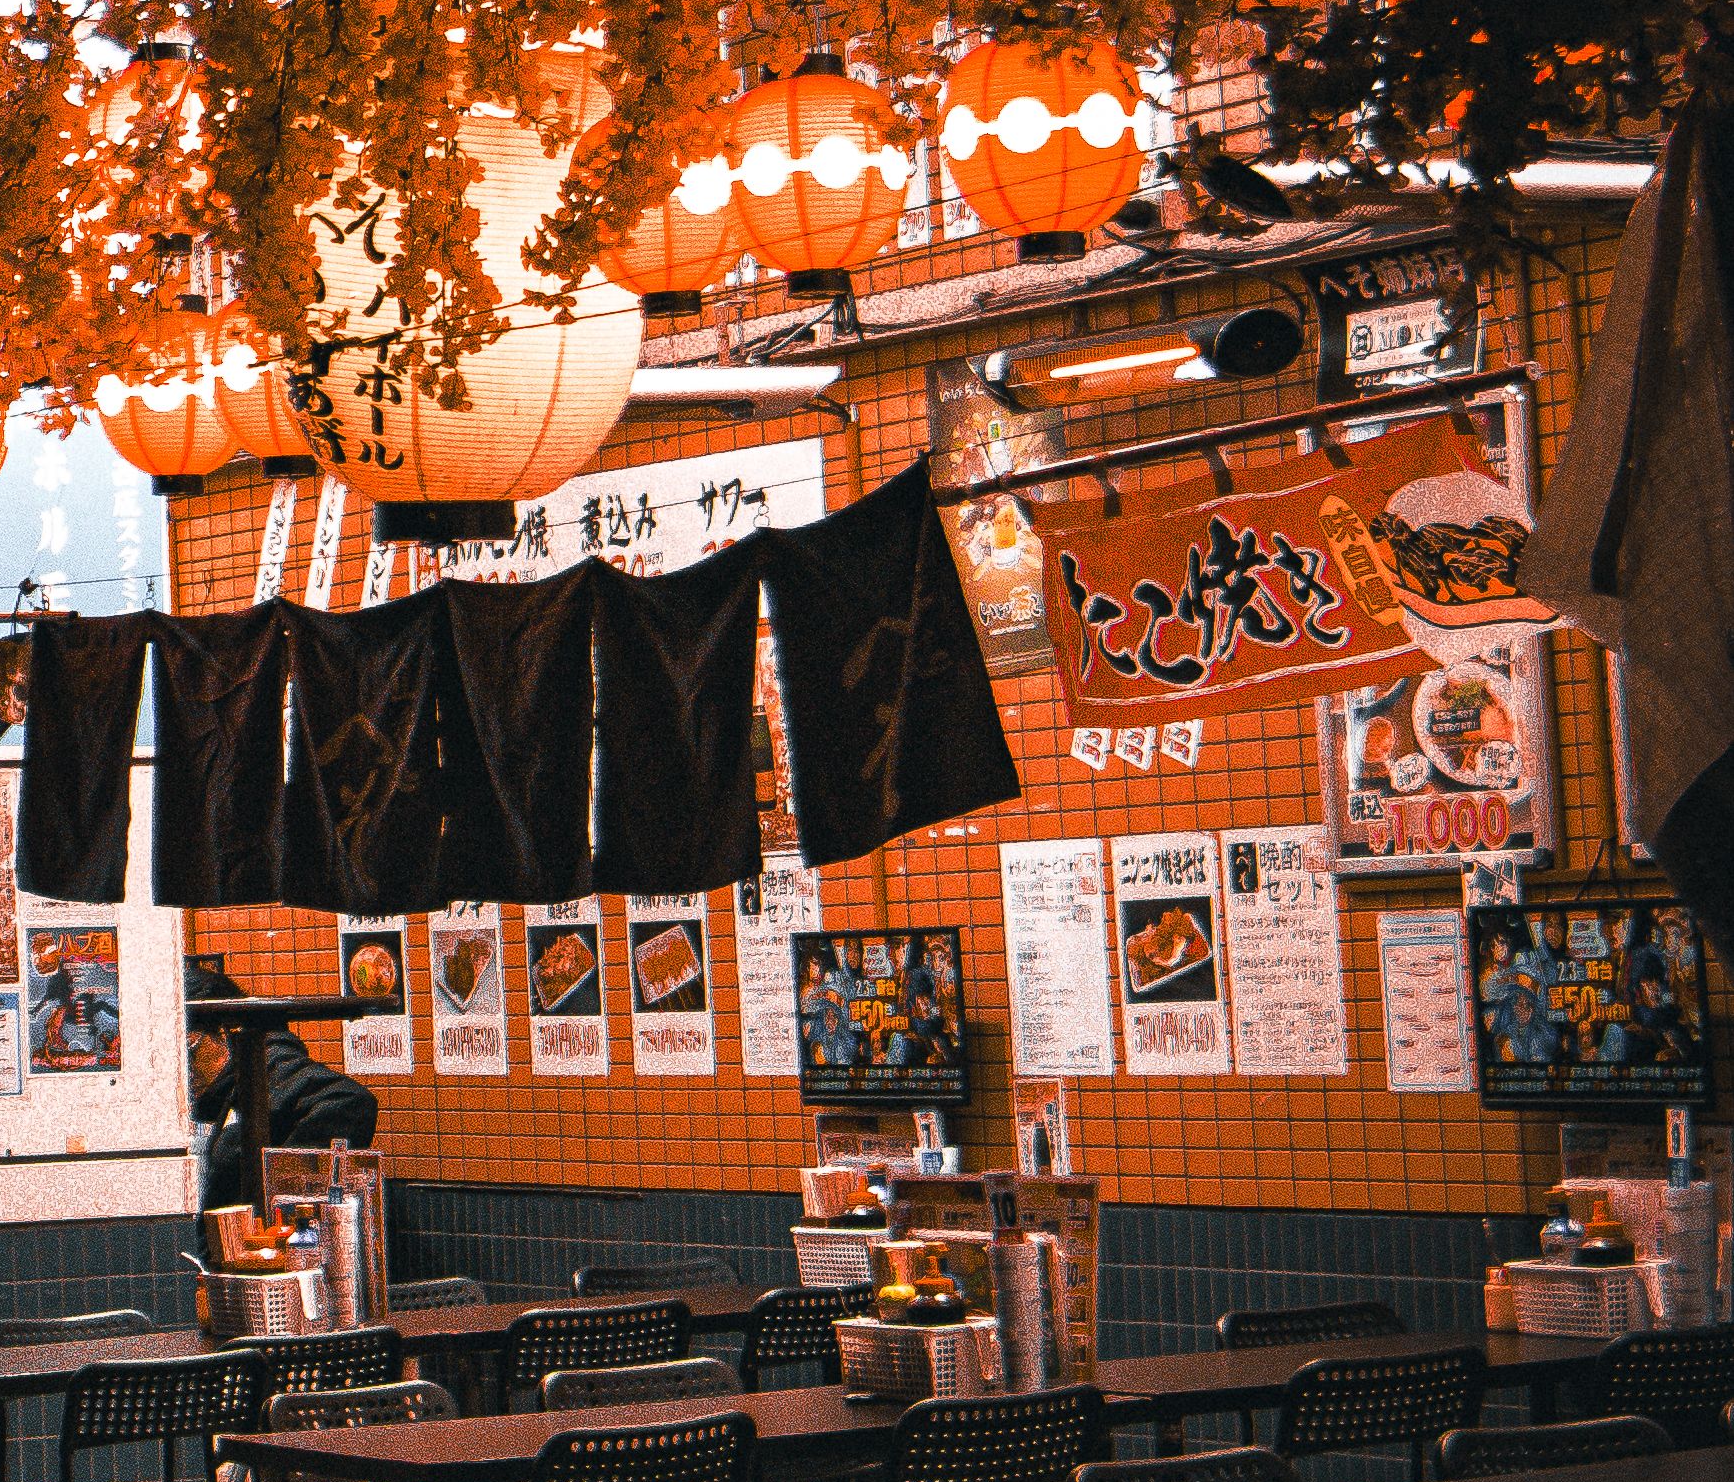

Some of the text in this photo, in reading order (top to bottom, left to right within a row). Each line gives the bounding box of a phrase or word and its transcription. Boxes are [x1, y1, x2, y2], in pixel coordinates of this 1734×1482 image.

[580, 493, 658, 553] 煮込み
[698, 476, 767, 533] サワー
[1319, 506, 1399, 616] 味自慢
[1058, 514, 1353, 687] たこ焼き
[1349, 794, 1384, 822] 税込
[1368, 795, 1510, 854] ¥1,000
[1259, 841, 1302, 872] 晩酌
[762, 869, 795, 897] 晩酌
[1262, 871, 1324, 903] セット
[764, 897, 811, 924] セット
[56, 931, 113, 955] ハブ酒
[990, 1191, 1017, 1228] 10
